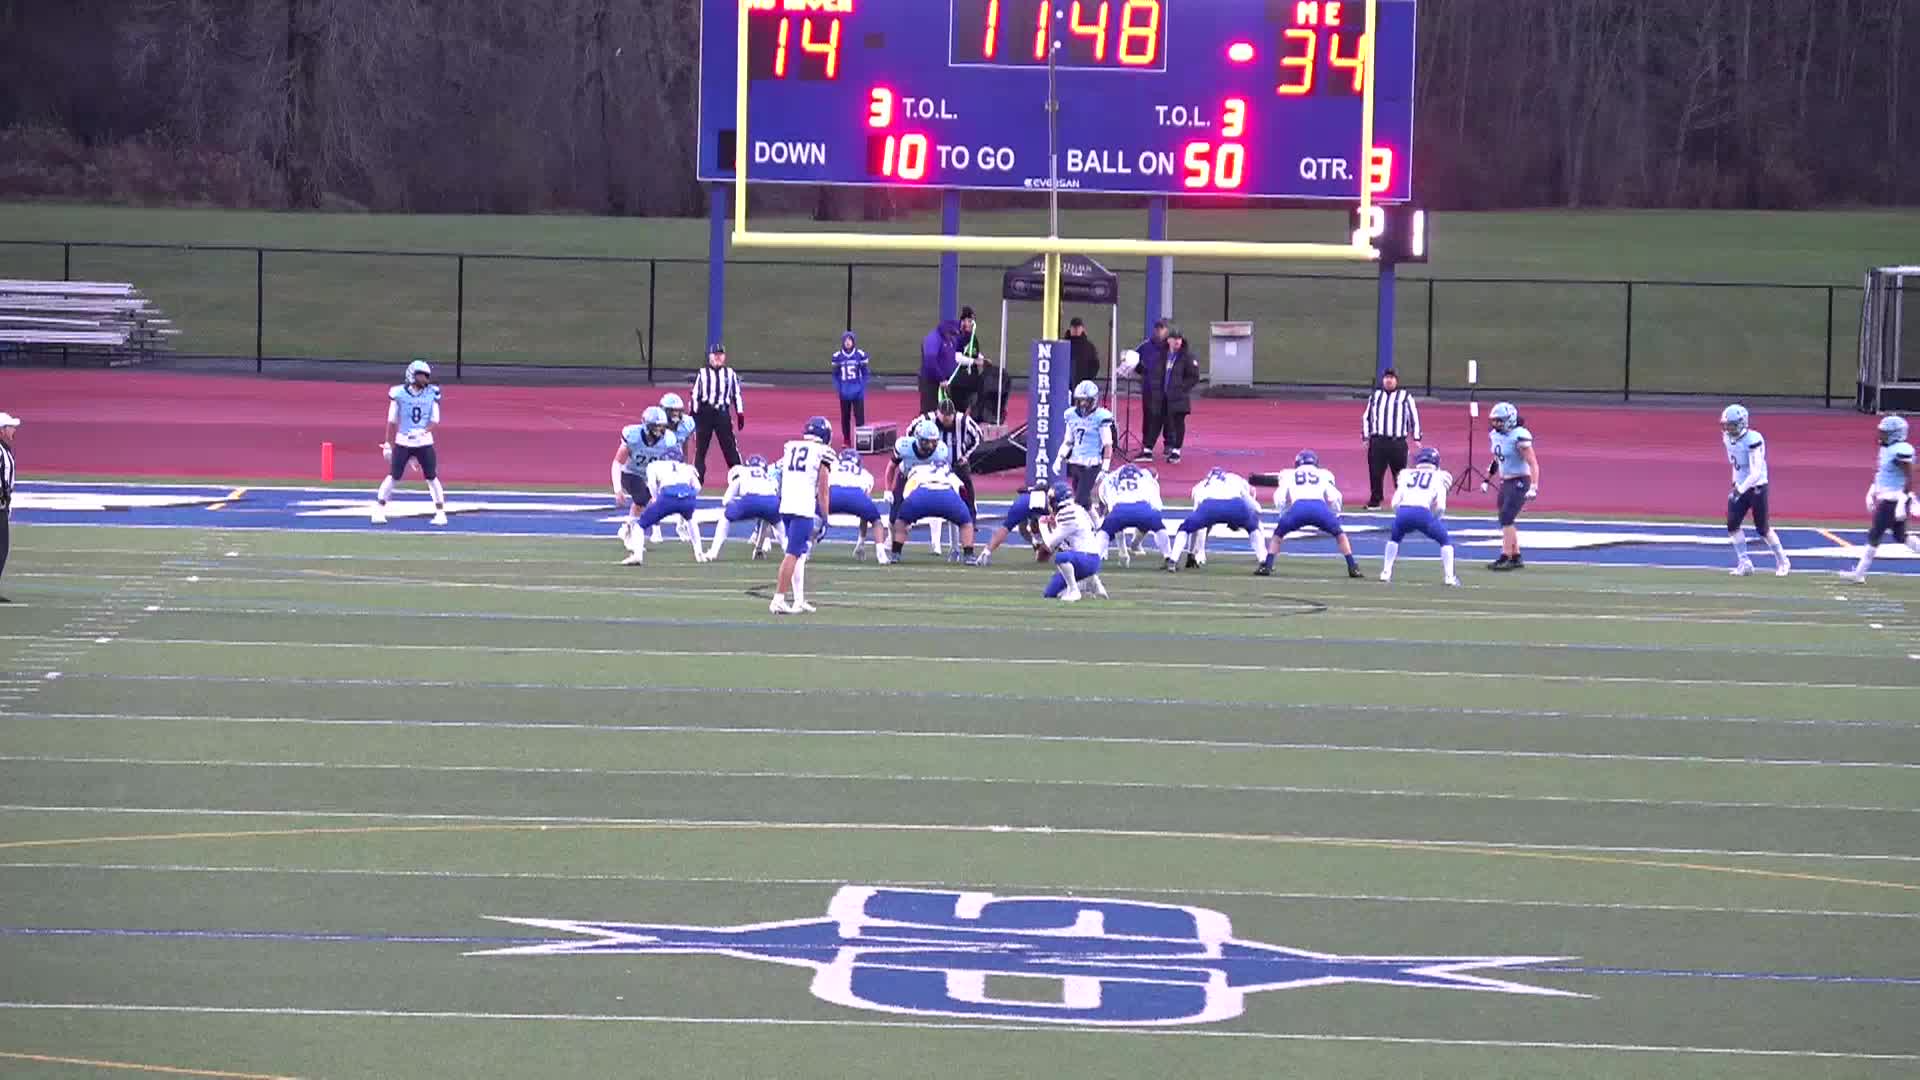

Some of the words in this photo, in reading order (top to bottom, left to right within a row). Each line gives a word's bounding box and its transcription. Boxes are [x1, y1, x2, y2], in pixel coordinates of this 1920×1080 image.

[775, 17, 839, 78] 14
[1277, 28, 1370, 94] 34
[869, 87, 892, 128] 3
[902, 97, 958, 119] T.O.L.
[1155, 105, 1211, 127] T.O.L.
[1222, 98, 1245, 138] 3
[755, 141, 825, 165] DOWN
[882, 133, 927, 181] 10
[937, 145, 969, 169] TO
[977, 147, 1015, 171] GO
[1067, 149, 1131, 174] BALL
[1139, 151, 1174, 175] ON
[1184, 141, 1245, 189] 50
[1300, 157, 1353, 180] QTR.
[841, 365, 857, 381] 15
[411, 406, 422, 424] 8
[1076, 427, 1086, 446] 7
[788, 446, 809, 473] 12
[1294, 470, 1320, 486] 85
[1406, 470, 1433, 490] 30
